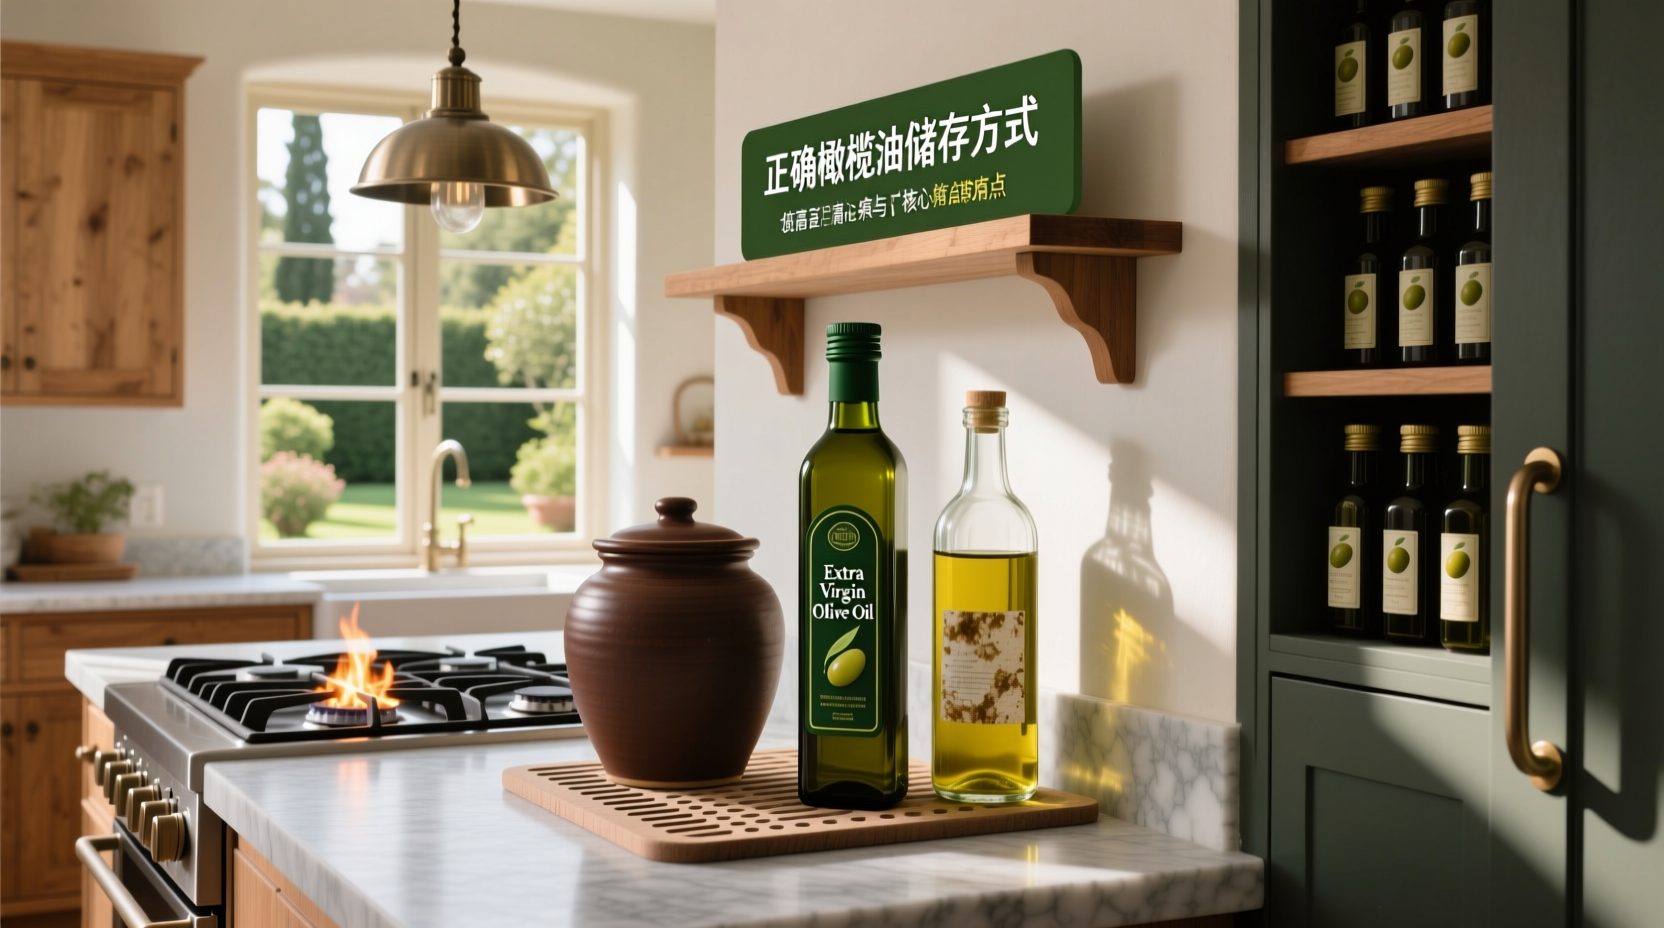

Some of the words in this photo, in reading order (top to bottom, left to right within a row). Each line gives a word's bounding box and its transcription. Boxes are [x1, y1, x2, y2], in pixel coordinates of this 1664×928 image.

[764, 94, 1039, 196] 正确橄榄油储存方式
[823, 564, 864, 580] Extra
[819, 582, 866, 604] Virgin
[812, 602, 850, 620] Olive
[852, 603, 874, 620] Oil
